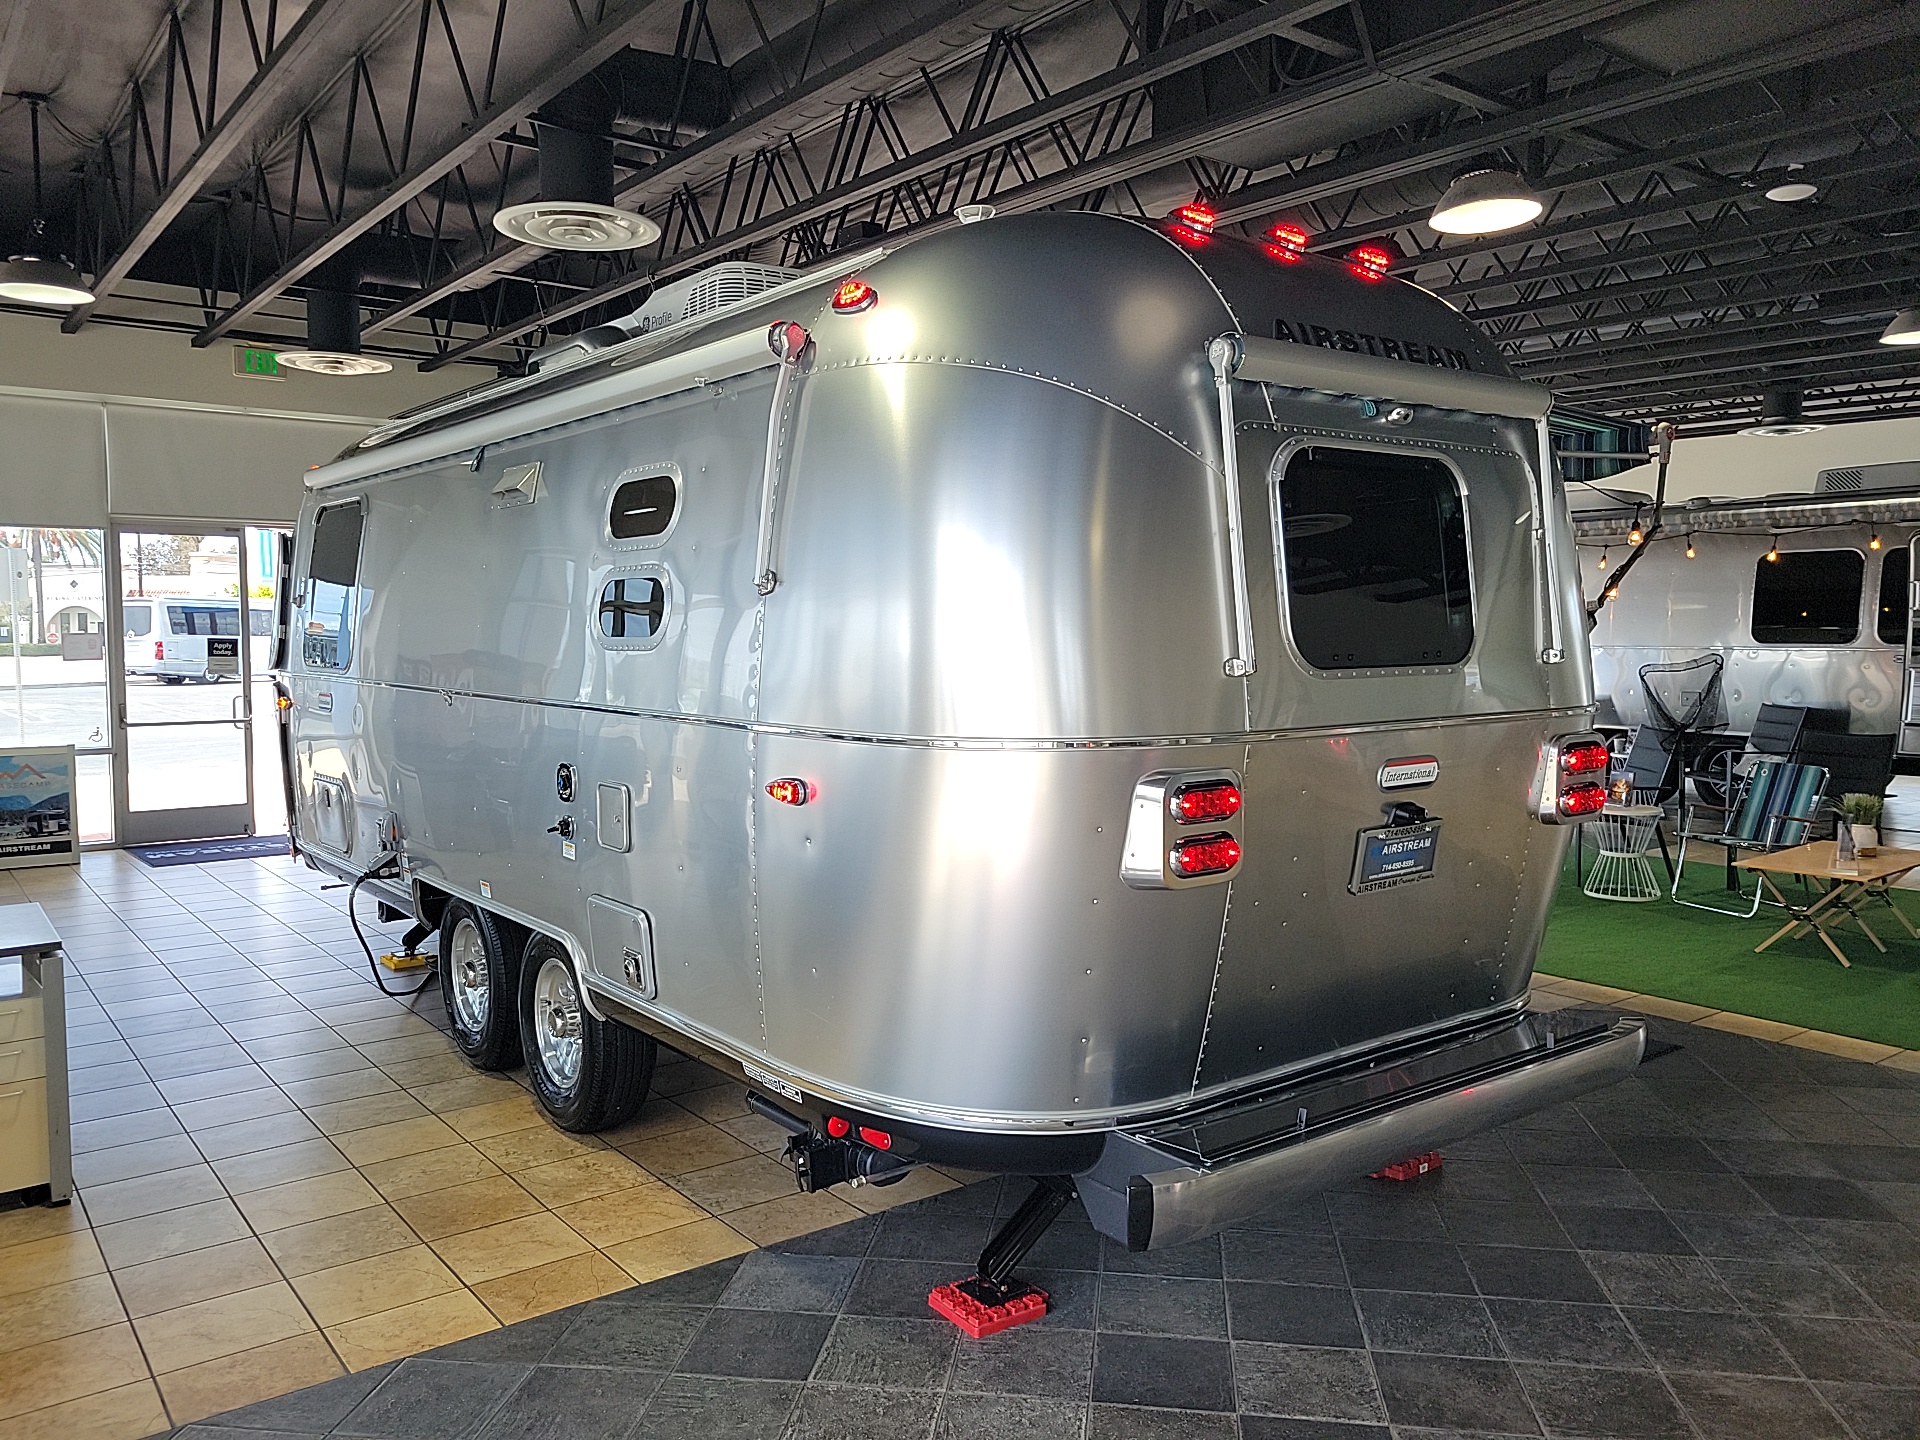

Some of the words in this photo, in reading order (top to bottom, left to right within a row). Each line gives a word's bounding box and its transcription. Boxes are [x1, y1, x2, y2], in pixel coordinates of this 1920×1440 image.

[651, 311, 672, 328] Profile
[1274, 318, 1471, 370] AIRSTREAM
[245, 349, 277, 375] EXIT
[213, 642, 233, 650] Apply
[1384, 766, 1436, 783] International
[1381, 837, 1432, 856] AIRSTREAM
[1356, 879, 1398, 895] AIRSTREAM
